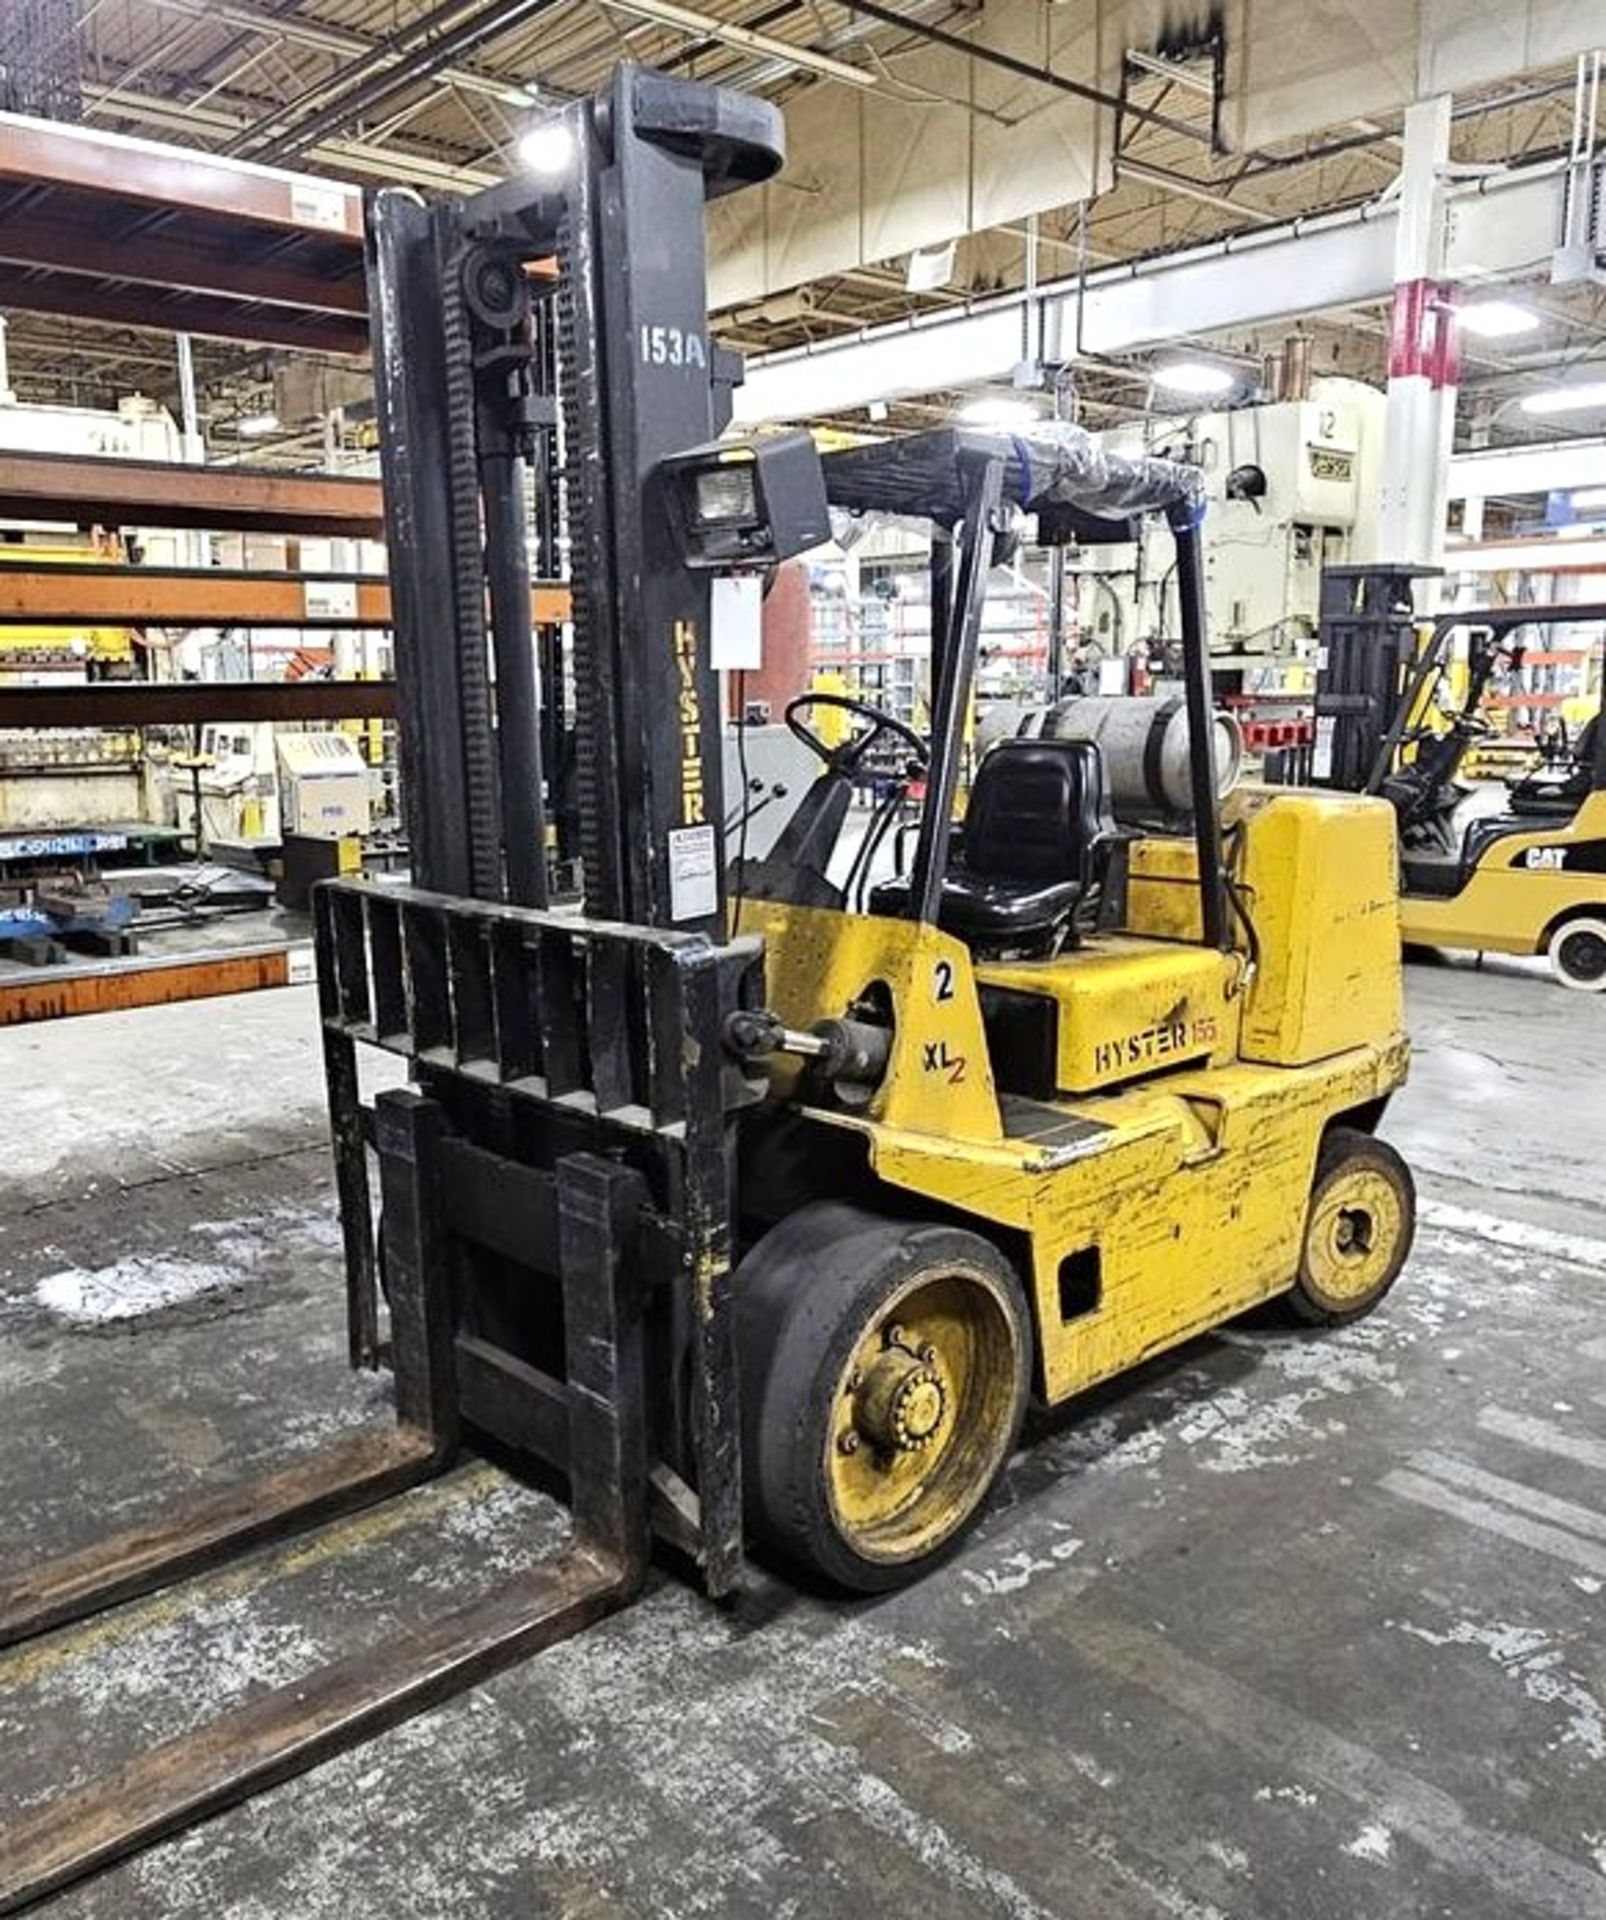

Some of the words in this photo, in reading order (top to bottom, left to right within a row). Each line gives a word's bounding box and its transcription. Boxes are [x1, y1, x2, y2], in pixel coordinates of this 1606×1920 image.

[641, 324, 706, 368] 153A
[675, 620, 705, 825] HYSTER
[1526, 847, 1568, 869] CAT
[935, 961, 954, 1002] 2
[1095, 1021, 1186, 1074] HYSTER
[1192, 1016, 1216, 1046] 155
